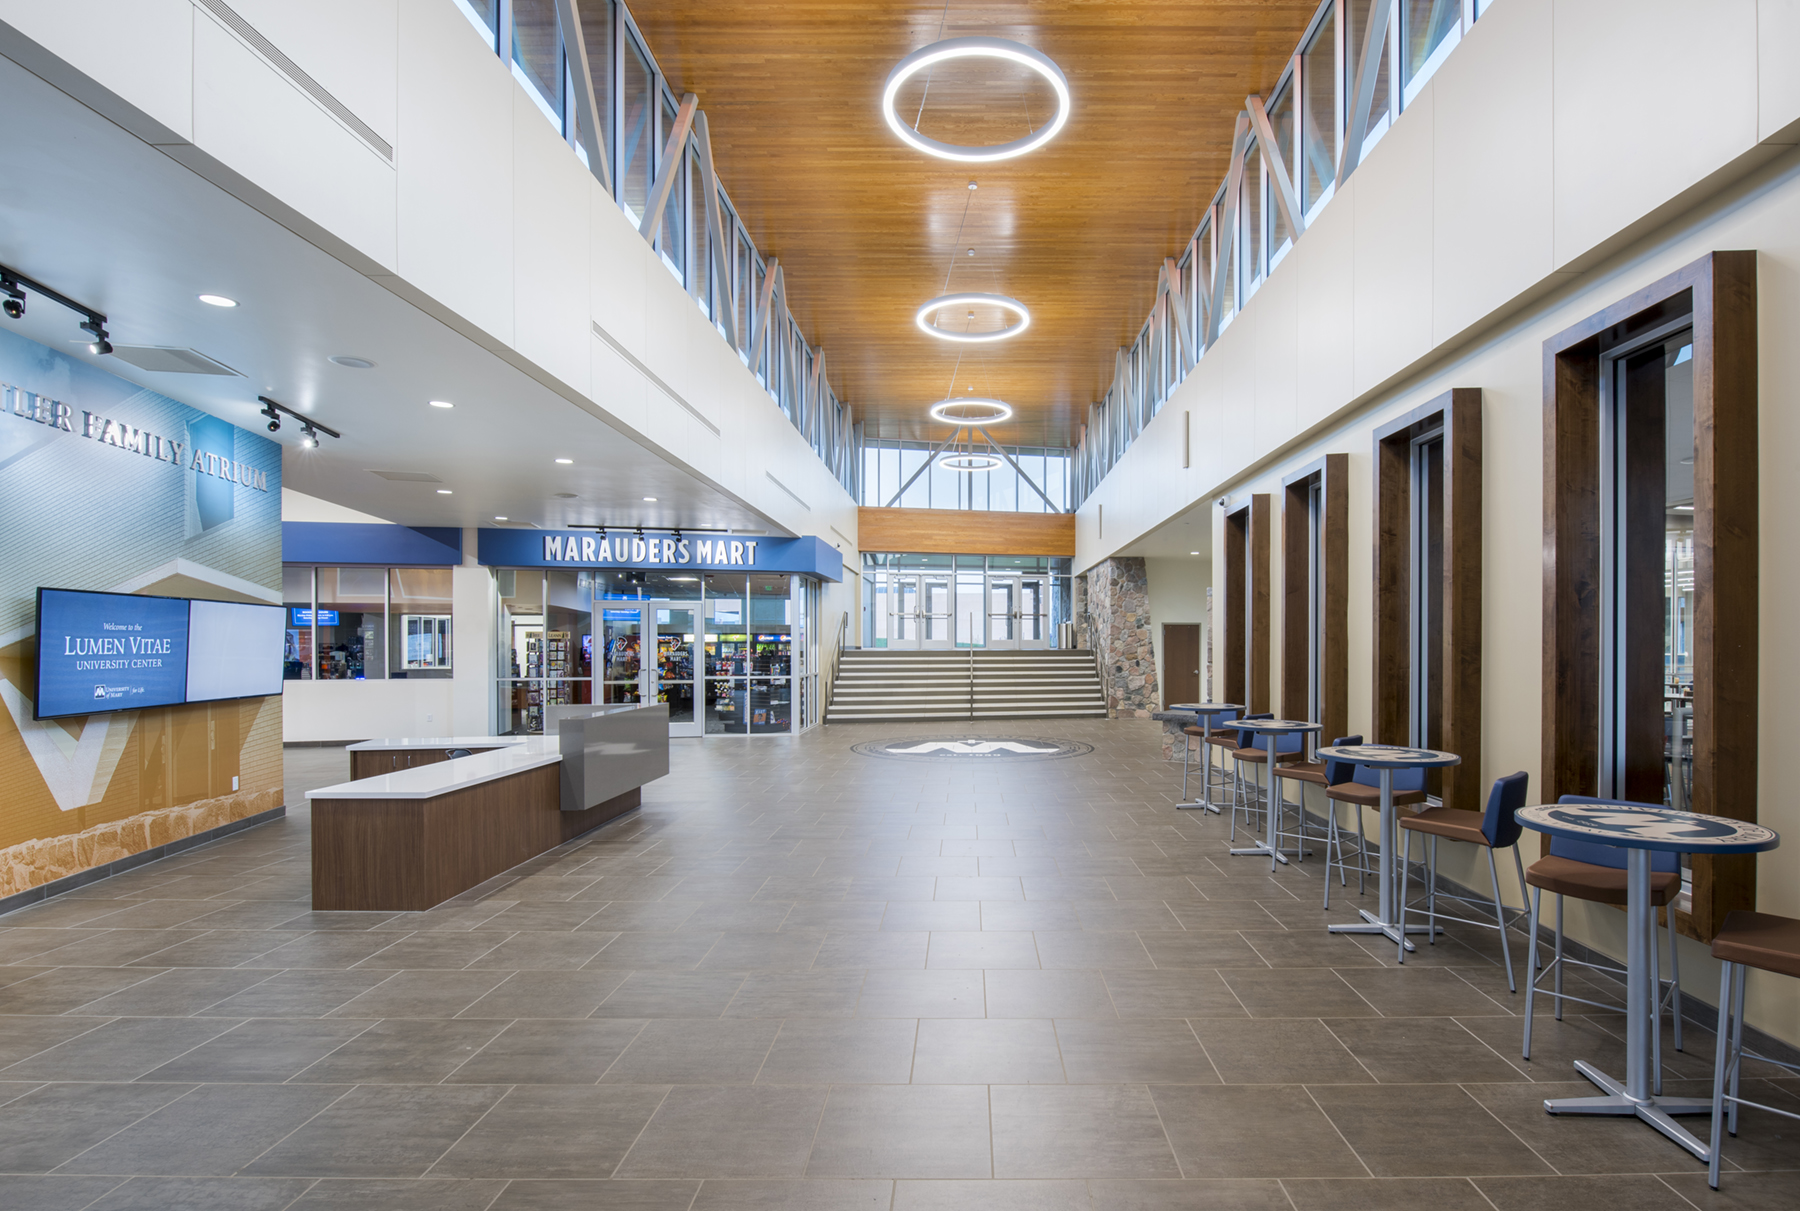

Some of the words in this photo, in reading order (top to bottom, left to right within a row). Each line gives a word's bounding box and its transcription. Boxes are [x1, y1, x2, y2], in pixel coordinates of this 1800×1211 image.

[82, 410, 185, 466] FAMILY
[190, 448, 268, 493] ATRIUM
[543, 535, 691, 565] MARAUDERS
[696, 539, 758, 566] MART
[103, 622, 127, 631] Welcome
[127, 623, 133, 631] to
[134, 623, 143, 631] the
[64, 636, 125, 655] LUMEN
[129, 636, 171, 654] VITAE
[76, 660, 129, 670] UNIVERSITY
[131, 659, 162, 668] CENTER
